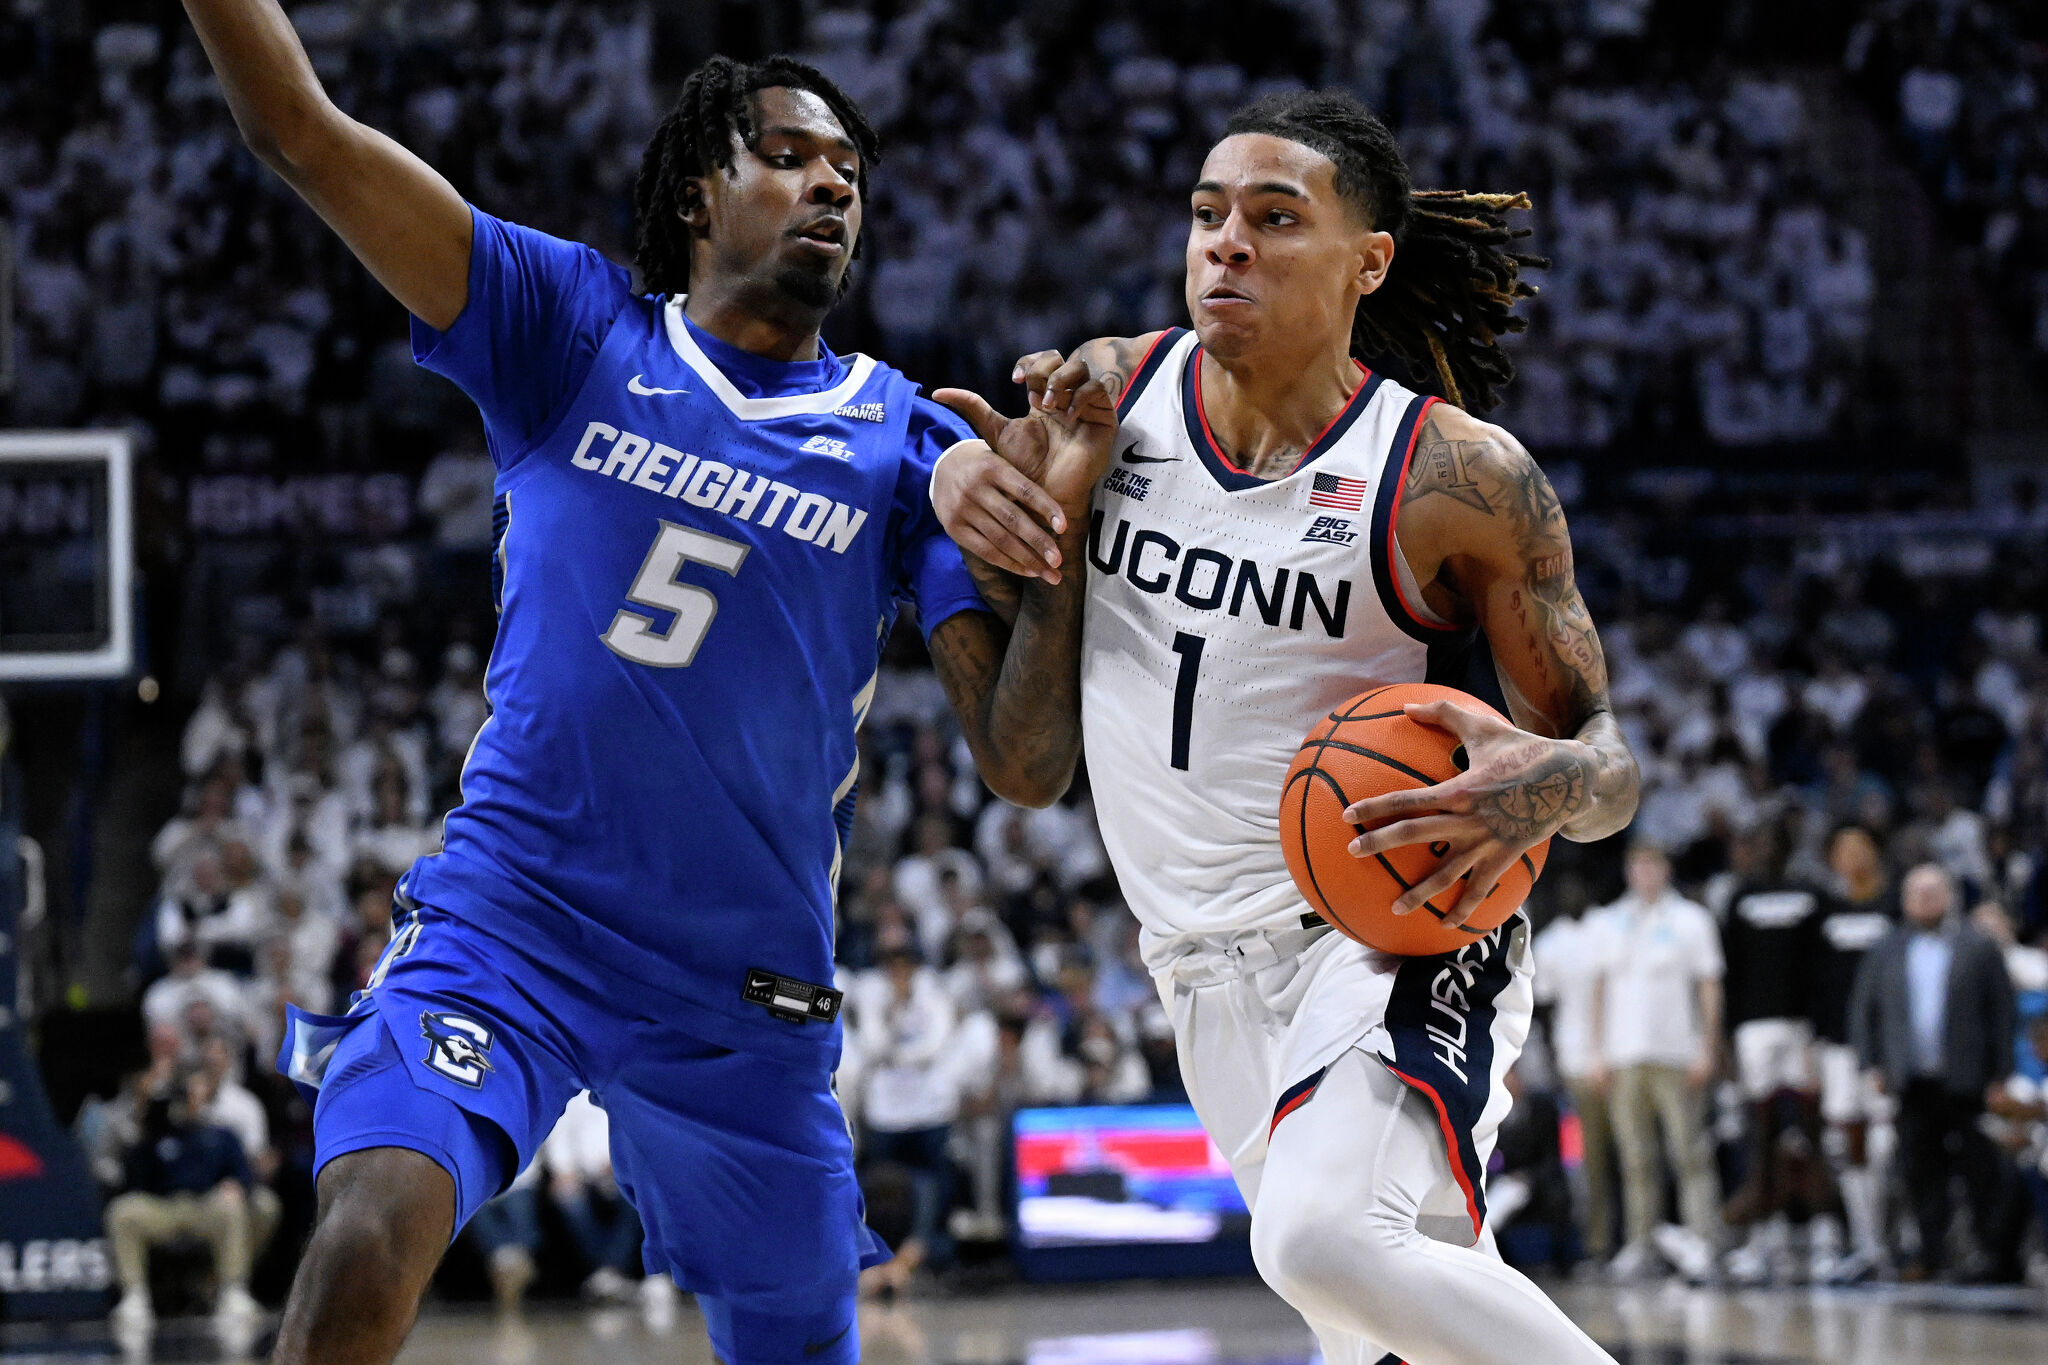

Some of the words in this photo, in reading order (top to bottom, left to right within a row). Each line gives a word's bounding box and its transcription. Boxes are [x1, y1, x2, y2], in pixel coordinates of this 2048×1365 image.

[833, 406, 885, 423] CHANGE
[801, 441, 856, 459] EAST
[808, 435, 848, 449] BIG
[570, 421, 868, 554] CREIGHTON
[1111, 468, 1129, 482] BE
[1128, 473, 1152, 490] THE
[1103, 478, 1149, 502] CHANGE
[1313, 516, 1352, 530] BIG
[1305, 527, 1358, 542] EAST
[1088, 509, 1352, 638] UCONN
[598, 518, 751, 668] 5
[1170, 630, 1206, 772] 1
[816, 996, 832, 1012] 46
